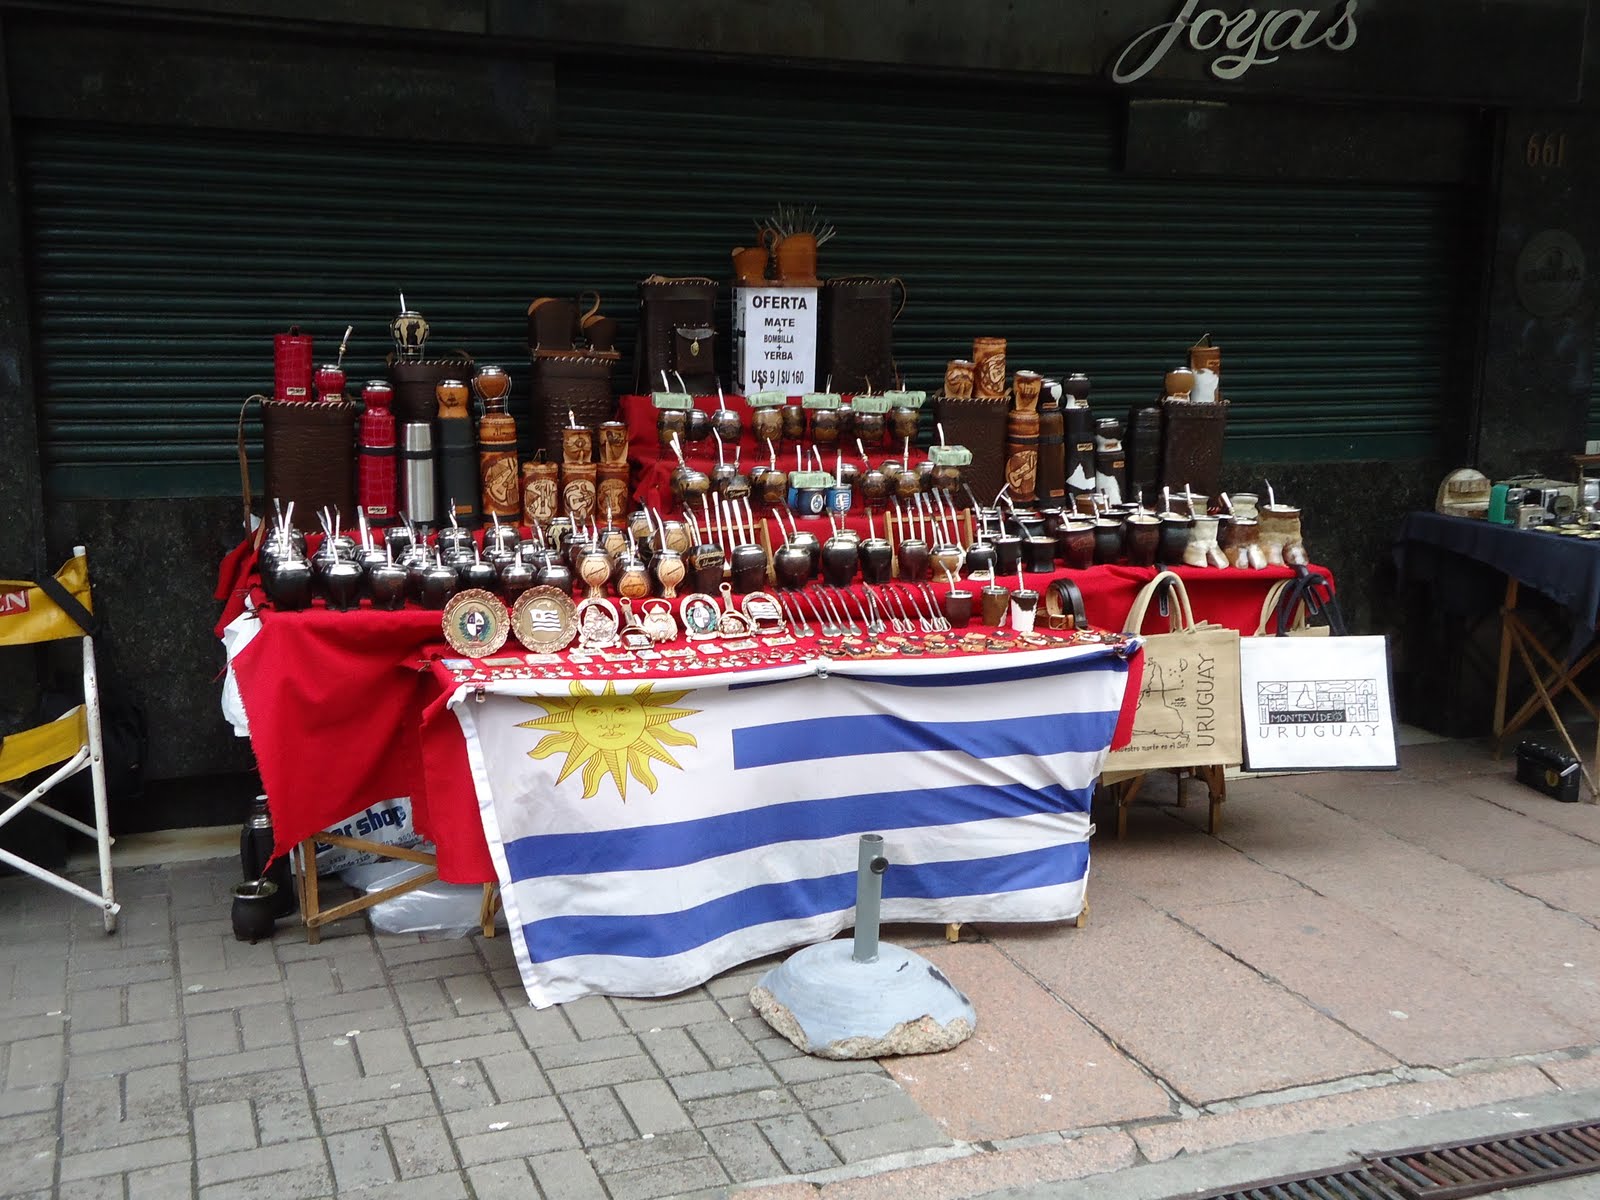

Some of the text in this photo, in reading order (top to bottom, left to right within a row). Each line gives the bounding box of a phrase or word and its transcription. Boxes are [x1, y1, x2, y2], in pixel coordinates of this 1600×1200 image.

[1112, 0, 1358, 84] Joyas
[1526, 133, 1566, 168] 661
[752, 295, 807, 310] OFERTA
[764, 318, 795, 327] MATE
[763, 334, 794, 343] BOMBILLA
[764, 351, 793, 360] YERBA
[770, 370, 775, 384] 9
[792, 370, 805, 384] 160
[1196, 653, 1215, 748] URUGUAY
[1270, 711, 1344, 723] MONTEVIDEO
[1258, 724, 1379, 738] URUGUAY
[356, 805, 407, 837] shop
